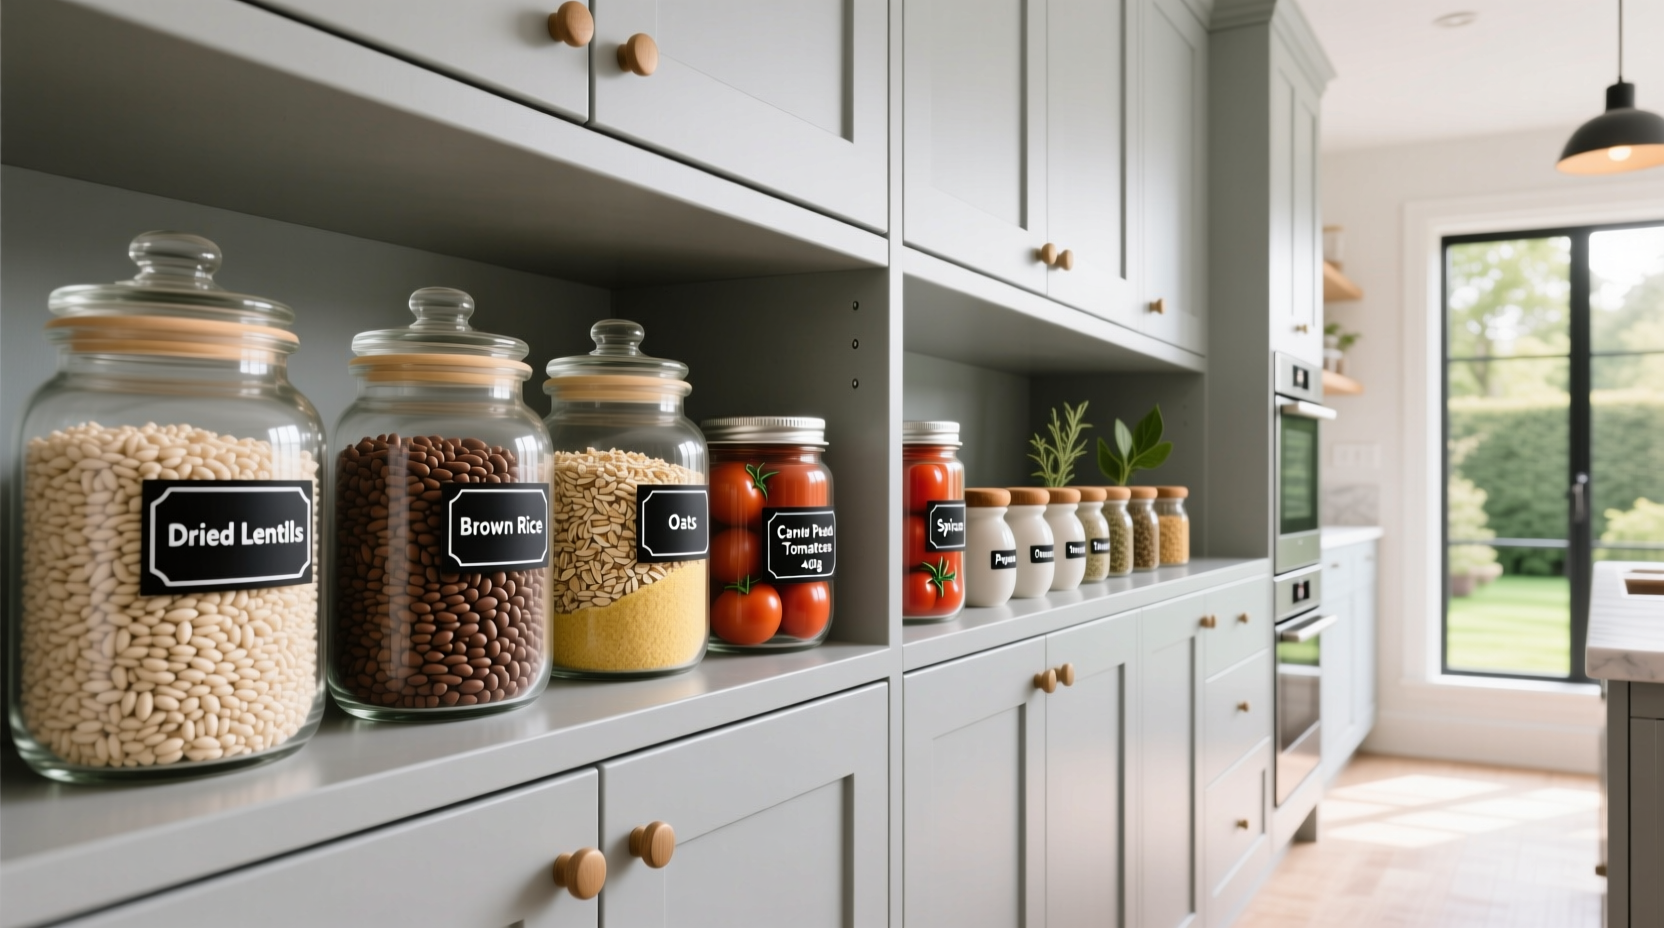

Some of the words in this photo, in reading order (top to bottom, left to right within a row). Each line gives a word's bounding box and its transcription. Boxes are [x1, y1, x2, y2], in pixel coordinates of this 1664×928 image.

[460, 516, 513, 536] Brown
[517, 515, 543, 534] Rice
[668, 513, 697, 531] Oats
[168, 522, 235, 547] Dried
